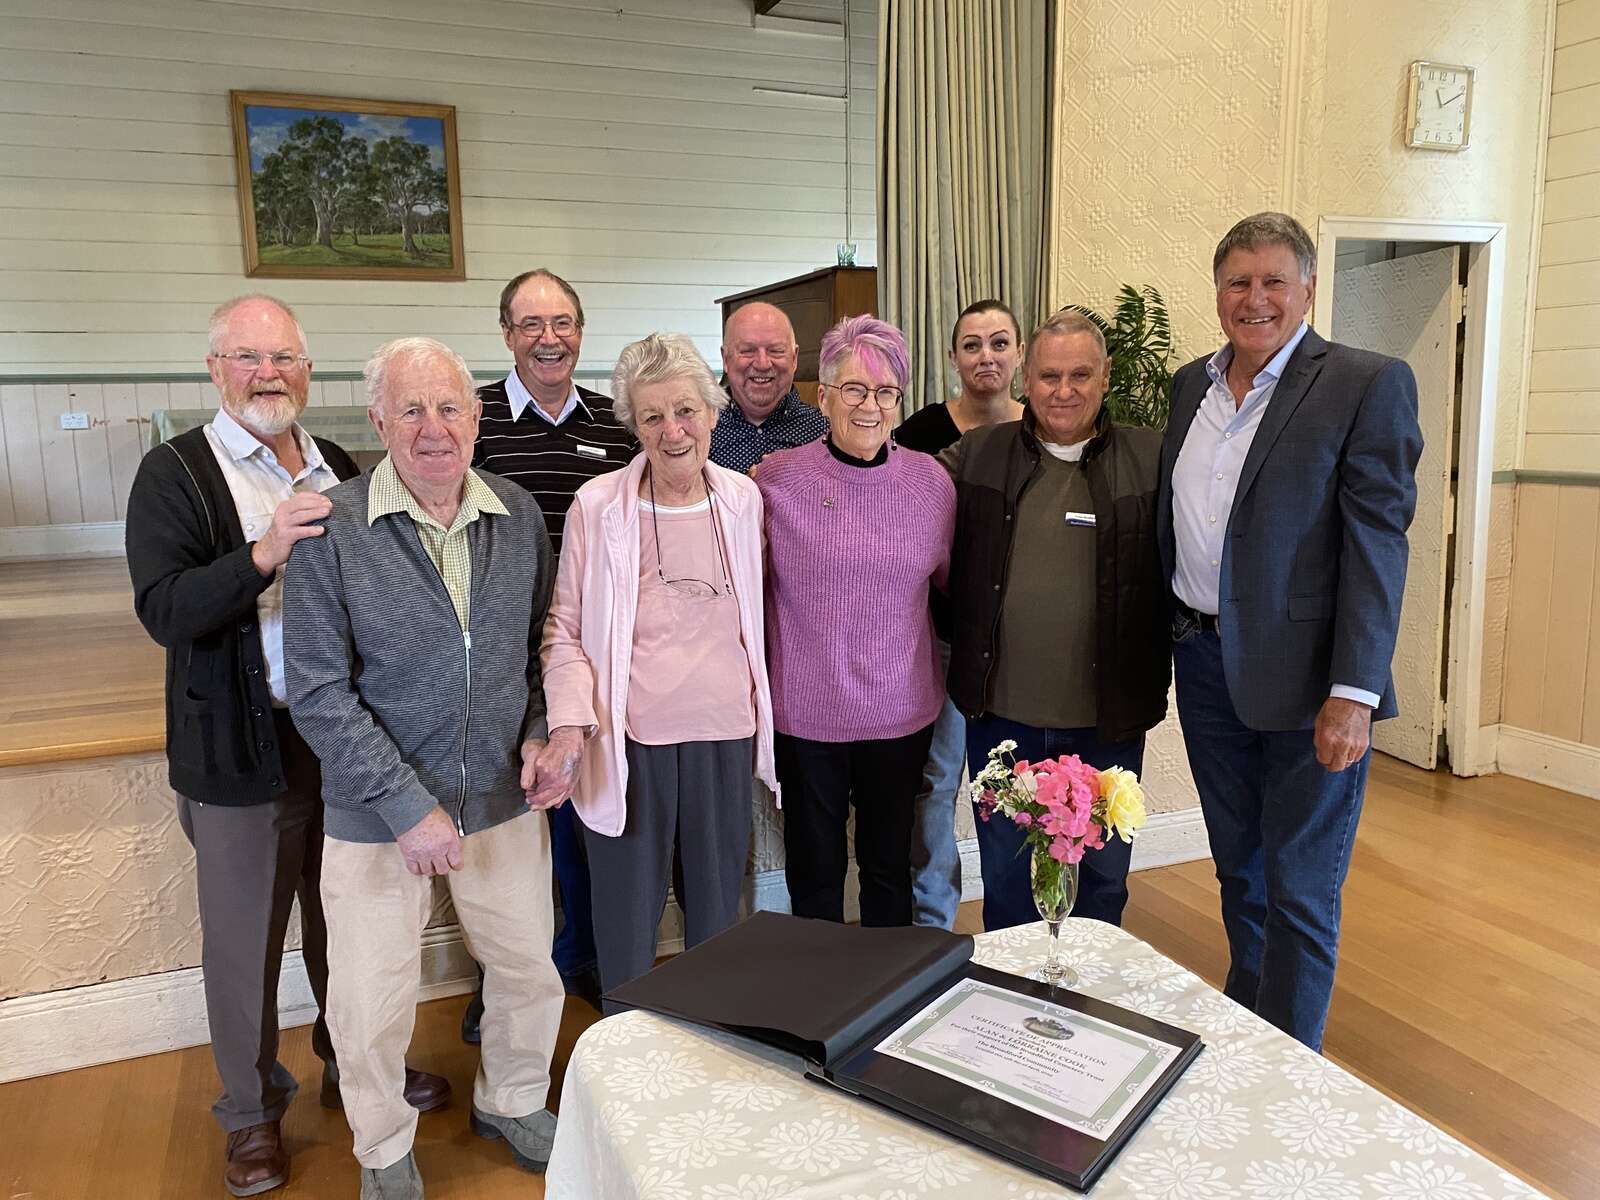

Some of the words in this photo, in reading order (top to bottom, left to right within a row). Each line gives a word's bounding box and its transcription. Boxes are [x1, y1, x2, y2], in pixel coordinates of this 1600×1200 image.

[1428, 71, 1435, 81] 11
[1439, 71, 1448, 82] 12
[971, 1015, 1025, 1037] CERTIFICATE
[1026, 1033, 1040, 1041] OF
[1040, 1038, 1108, 1067] APPRECIATION
[972, 1025, 1000, 1037] ALAN
[1008, 1037, 1058, 1059] LORRAINE
[1058, 1055, 1088, 1070] COOK
[990, 1045, 1023, 1059] Broadford
[1022, 1056, 1060, 1074] Community
